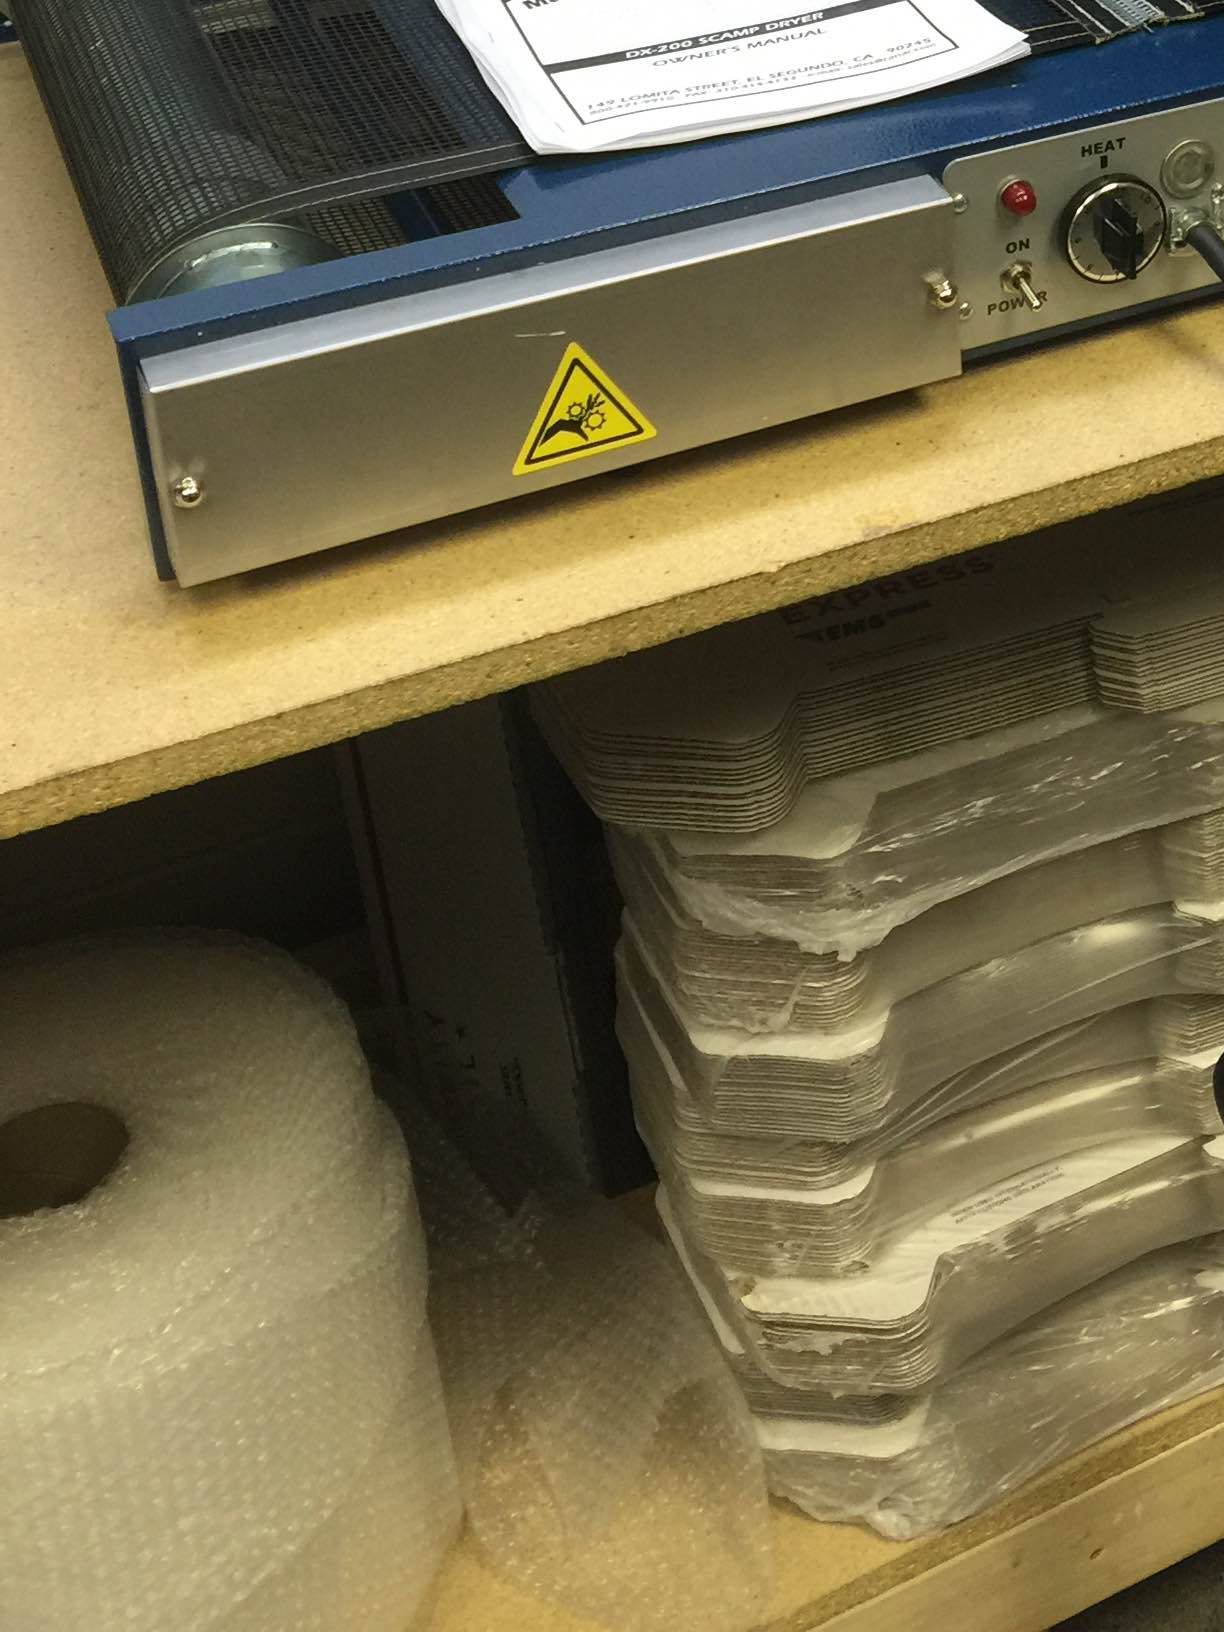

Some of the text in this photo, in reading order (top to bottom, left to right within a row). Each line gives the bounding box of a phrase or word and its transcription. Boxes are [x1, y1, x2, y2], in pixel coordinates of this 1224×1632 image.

[625, 11, 824, 59] DX-200 SCAMP DRYER
[652, 27, 828, 66] OWNER'S MANUAL
[620, 88, 680, 102] LOMITA
[746, 74, 764, 83] EL
[853, 53, 873, 62] CA
[1080, 136, 1126, 158] HEAT
[1006, 238, 1030, 254] ON
[987, 290, 1048, 316] POWR
[782, 555, 994, 625] EXPRESS
